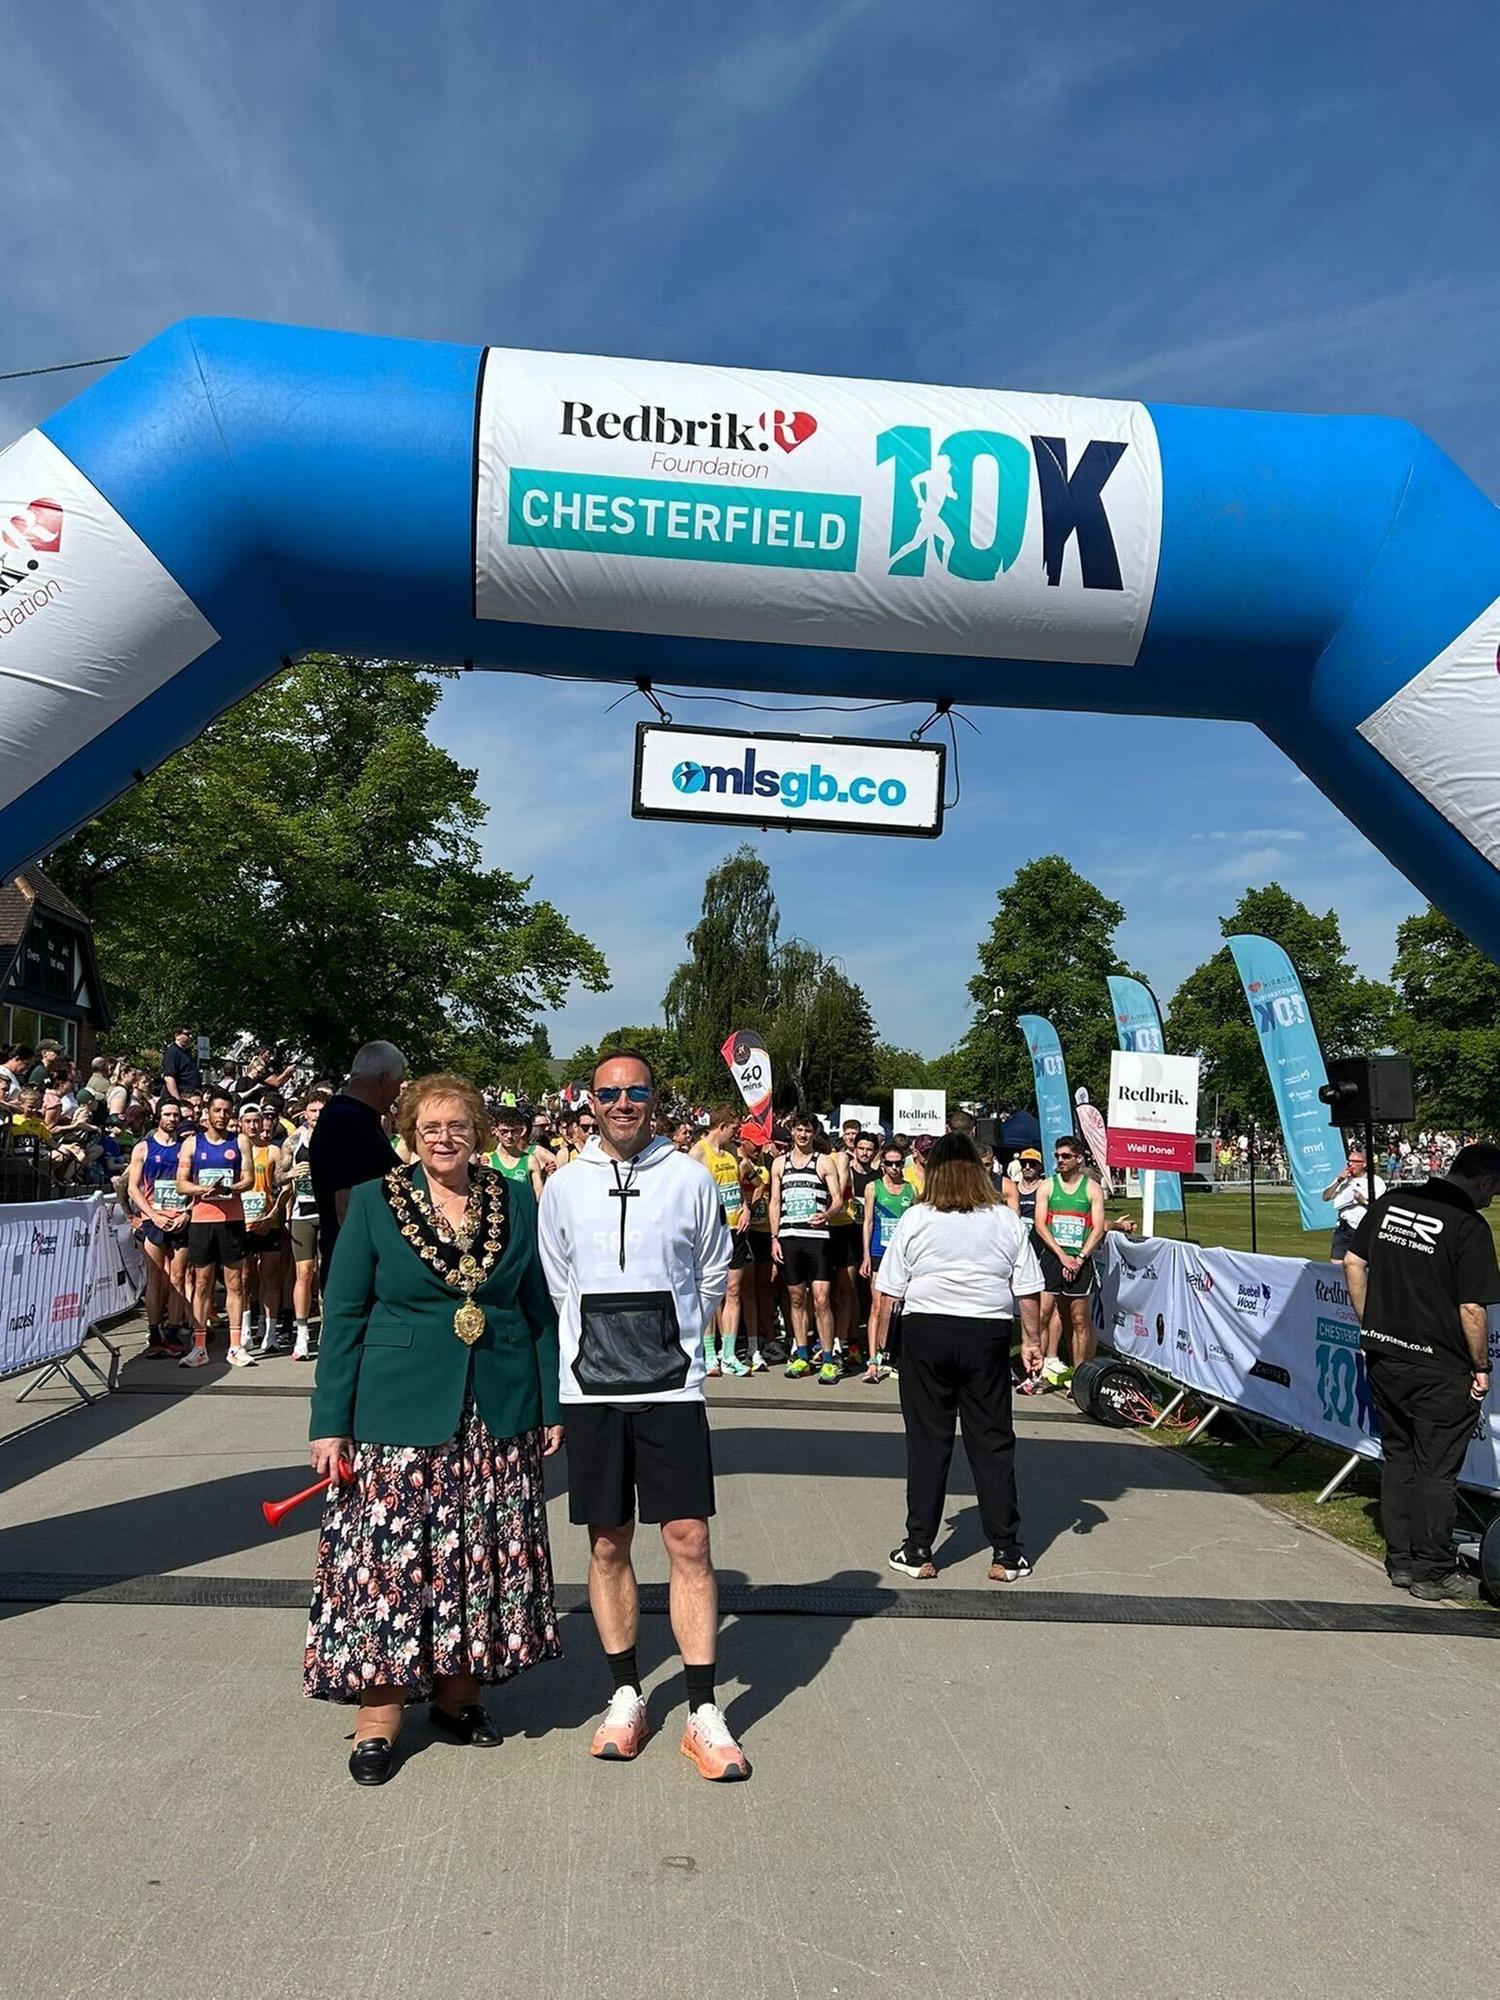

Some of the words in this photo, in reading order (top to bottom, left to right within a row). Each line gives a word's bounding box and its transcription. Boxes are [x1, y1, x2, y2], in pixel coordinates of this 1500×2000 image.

[650, 451, 769, 480] Foundation
[876, 424, 1129, 591] 10K
[520, 488, 847, 551] CHESTERFIELD
[0, 579, 62, 635] dation
[741, 1065, 763, 1082] 40
[743, 1082, 763, 1092] mins
[1118, 1085, 1189, 1106] Redbrik.
[899, 1109, 942, 1120] Redbrik.
[1127, 1143, 1148, 1153] Well
[1148, 1144, 1175, 1156] Done!
[786, 1199, 814, 1211] 2229
[1054, 1222, 1083, 1236] 1258
[1387, 1223, 1418, 1239] systems
[1377, 1231, 1408, 1247] SPORTS
[1408, 1240, 1435, 1255] TIMING
[1236, 1295, 1258, 1310] Wood
